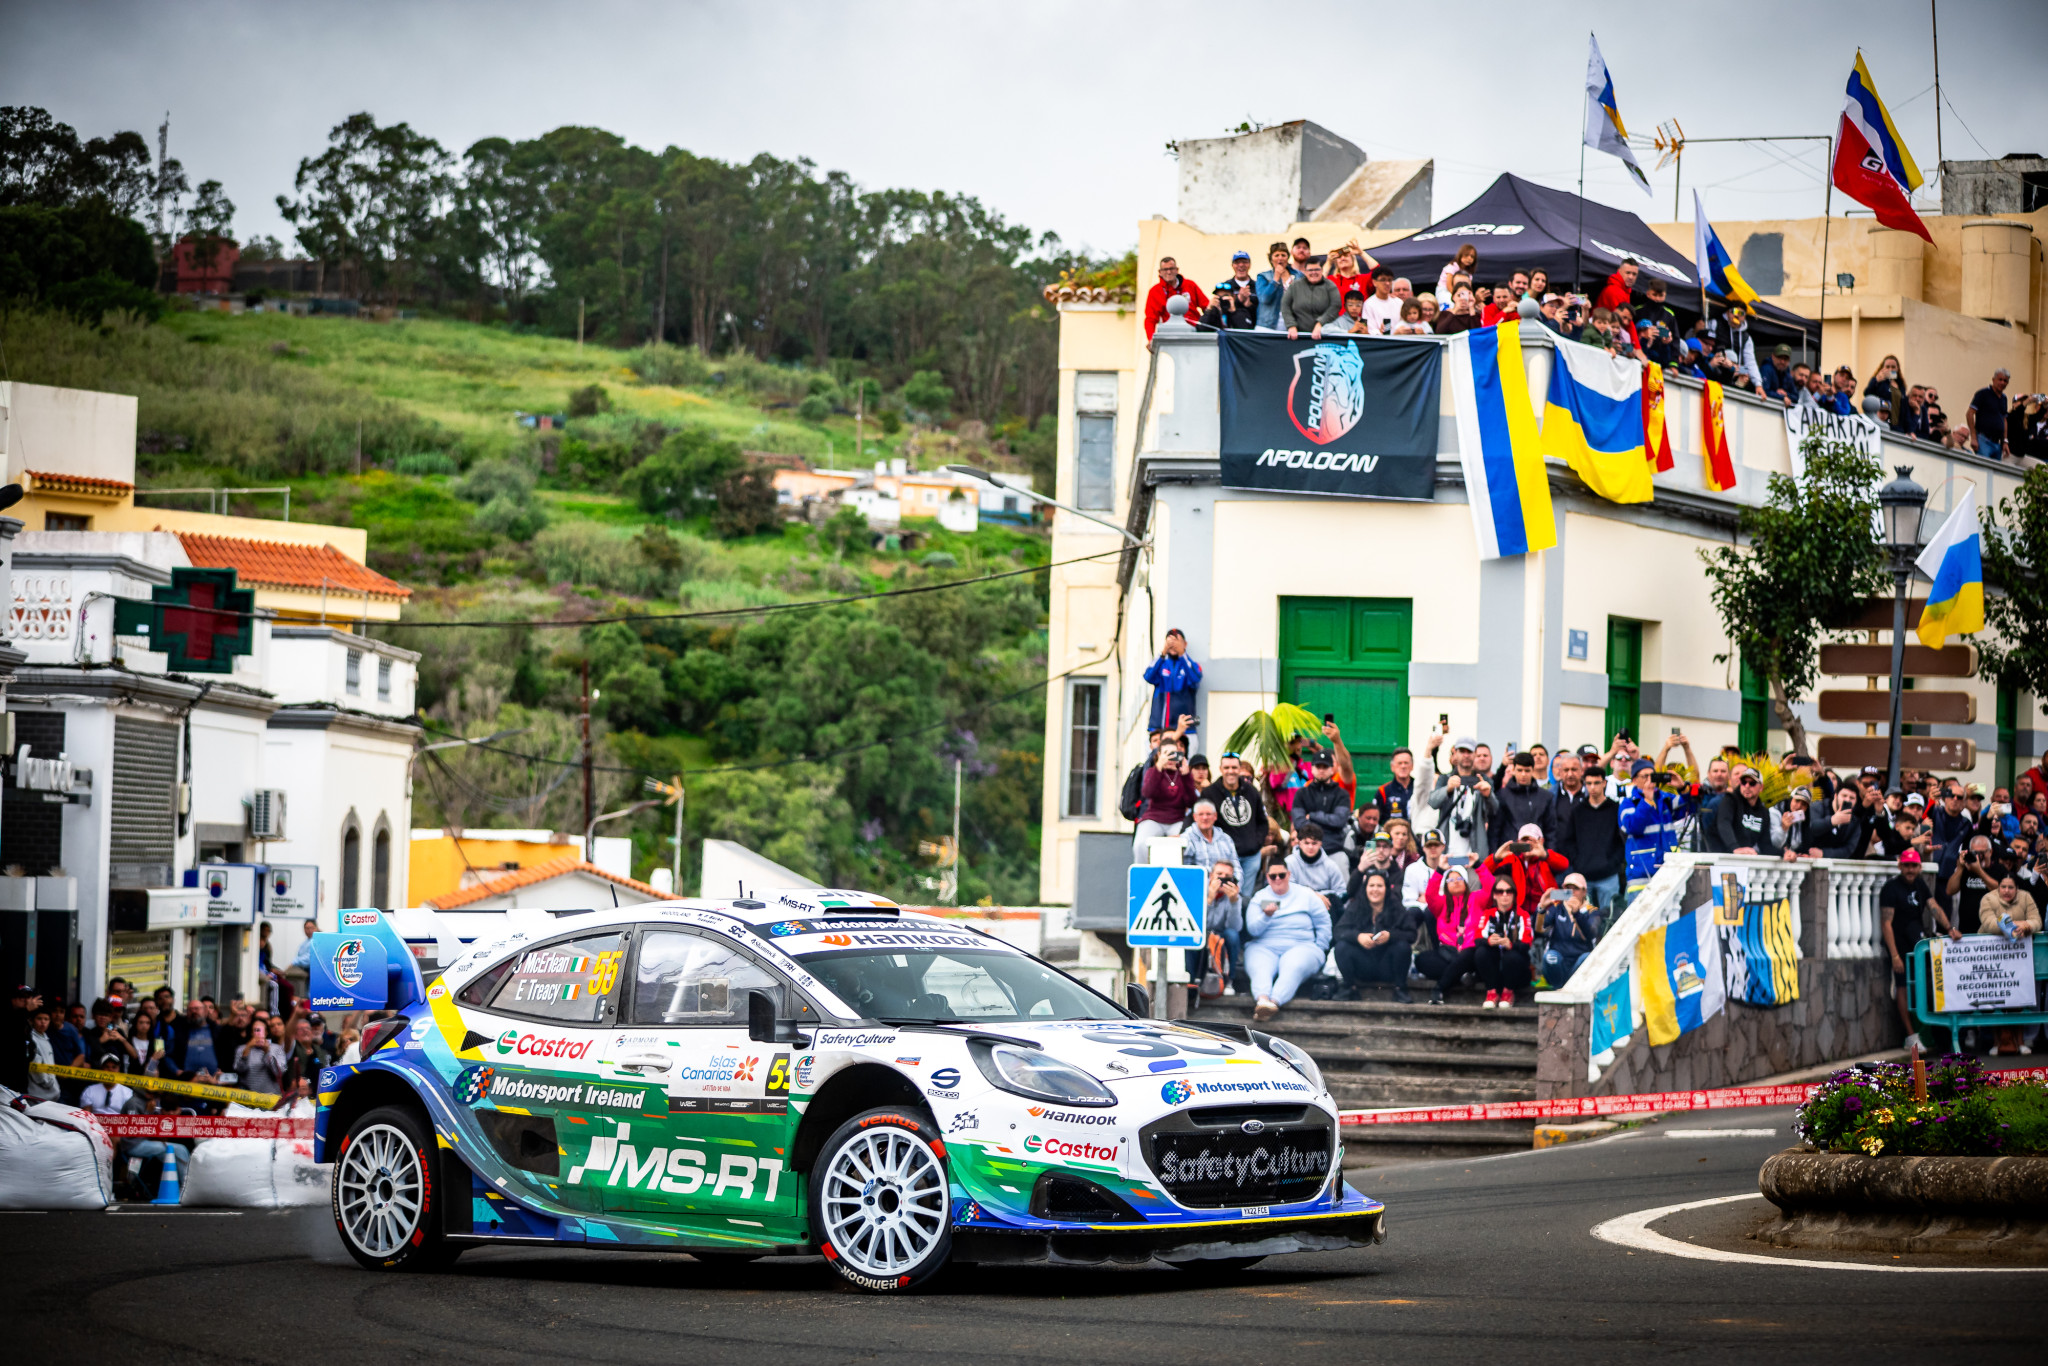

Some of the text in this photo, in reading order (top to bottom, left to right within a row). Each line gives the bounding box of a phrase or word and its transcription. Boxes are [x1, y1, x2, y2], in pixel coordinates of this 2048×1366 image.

[1256, 448, 1379, 474] APOLOCAN
[351, 913, 378, 924] Castrol
[811, 920, 914, 931] Motorsport
[1945, 951, 2028, 964] RECONOCIMIENTO
[513, 950, 624, 996] J McErlean 55
[1972, 963, 2002, 972] RALLY
[1934, 958, 1944, 992] AVISO
[1959, 971, 2016, 981] ONLY RALLY
[430, 987, 443, 996] BELL
[515, 979, 562, 1005] E Treacy
[1956, 980, 2020, 991] RECOGNITION
[1966, 990, 2012, 1000] VEHICLES
[312, 997, 355, 1007] SafetyCulture
[820, 1033, 896, 1047] SafetyCulture
[517, 1034, 594, 1060] Castrol
[709, 1055, 737, 1068] Islas
[682, 1066, 733, 1081] Canarias
[2003, 1069, 2030, 1081] PUBLICO
[47, 1064, 73, 1076] ZONA
[201, 1087, 228, 1099] ZONA
[1196, 1080, 1270, 1094] Motorsport
[491, 1076, 646, 1110] Motorsport Ireland
[1777, 1085, 1803, 1095] PUBLICO
[131, 1115, 159, 1125] PUBLICO
[1042, 1109, 1118, 1126] Hankook
[117, 1126, 127, 1135] NO
[128, 1126, 157, 1135] GO-AREA
[1044, 1137, 1119, 1162] Castrol
[606, 1142, 784, 1202] MS-RT
[1160, 1145, 1328, 1188] SafetyCulture
[1243, 1206, 1268, 1216] YX22 FCE
